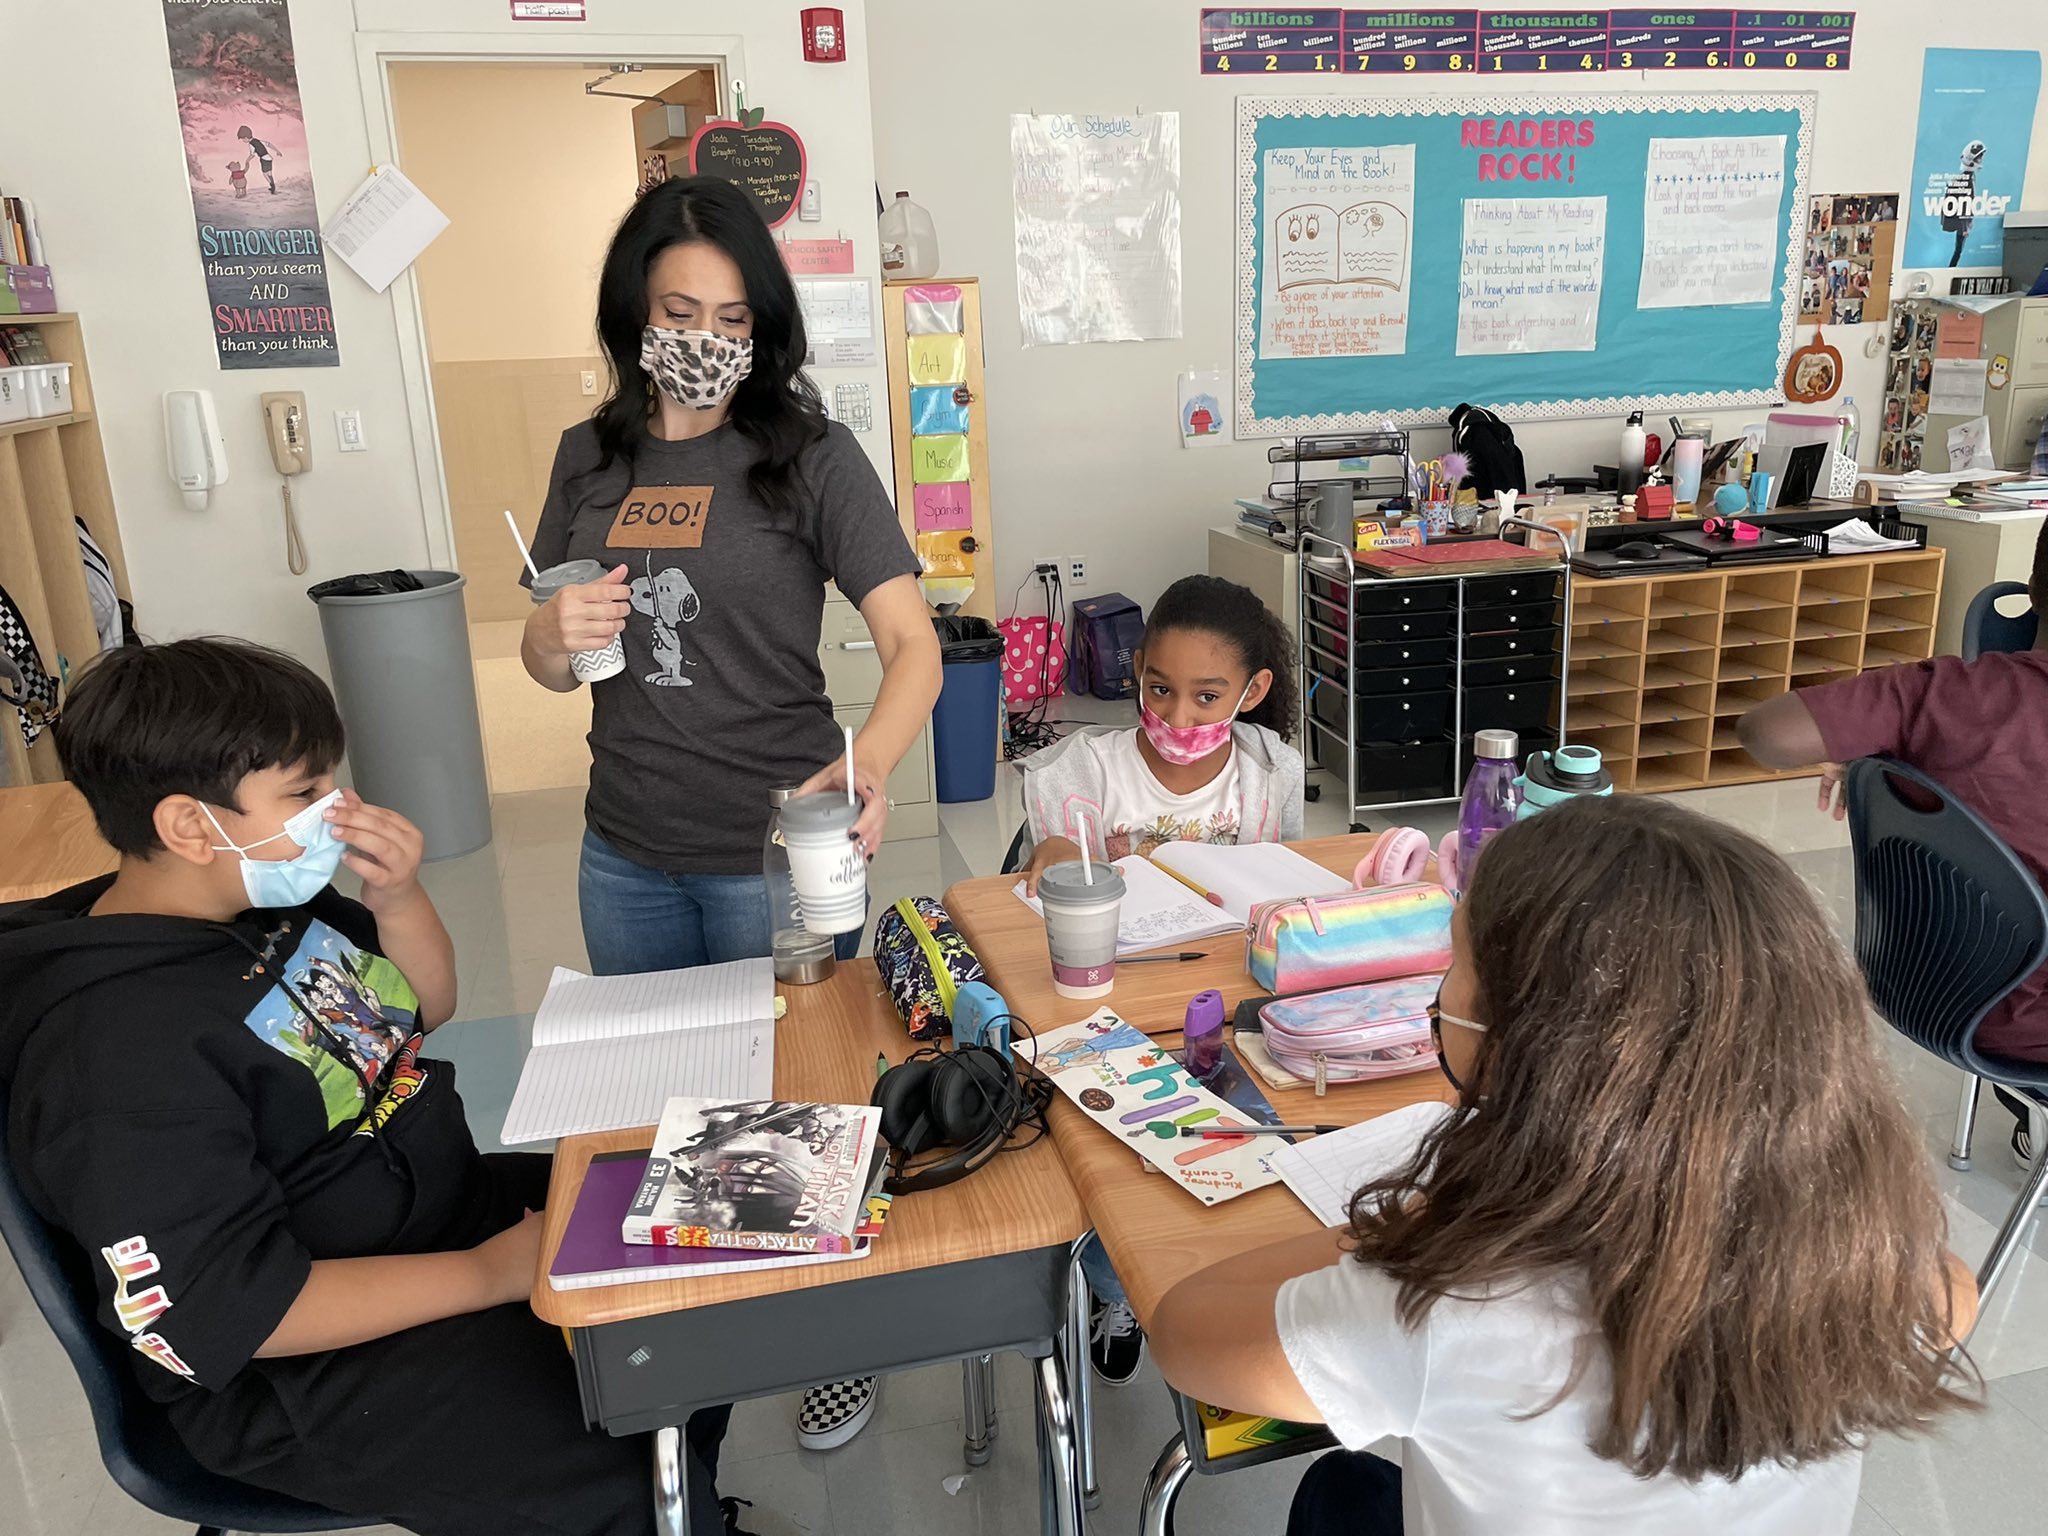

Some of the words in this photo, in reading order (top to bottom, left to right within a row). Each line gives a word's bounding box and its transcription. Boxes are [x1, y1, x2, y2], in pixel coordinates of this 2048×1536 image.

[524, 4, 546, 15] half
[547, 4, 570, 17] past
[1230, 12, 1315, 26] billions
[1366, 12, 1456, 27] millions
[1489, 14, 1599, 28] thousands
[1650, 14, 1696, 25] ones
[1747, 14, 1762, 25] .1
[1781, 14, 1806, 26] .01
[1816, 14, 1851, 28] .001
[1211, 31, 1247, 45] hundred
[1256, 33, 1271, 42] ten
[1257, 37, 1288, 50] billions
[1302, 35, 1334, 48] billions
[1352, 31, 1387, 46] hundred
[1393, 33, 1408, 43] ten
[1394, 37, 1427, 50] millions
[1436, 35, 1468, 48] millions
[1483, 32, 1517, 46] hundred
[1527, 34, 1542, 42] ten
[1528, 35, 1568, 50] thousands
[1567, 33, 1607, 47] thousands
[1615, 33, 1652, 47] hundreds
[1663, 36, 1680, 45] tens
[1703, 36, 1721, 46] ones
[1741, 36, 1765, 47] tenths
[1774, 33, 1816, 48] hundredths
[1811, 35, 1850, 49] thousandths
[1212, 40, 1244, 53] billions
[1353, 40, 1386, 53] millions
[1484, 38, 1524, 53] thousands
[1217, 55, 1231, 71] 4
[1265, 55, 1278, 71] 2
[1358, 55, 1370, 71] 7
[1403, 55, 1417, 71] 9
[1493, 55, 1503, 71] 1
[1538, 54, 1548, 70] 1
[1621, 52, 1633, 68] 3
[1664, 51, 1677, 67] 2
[1744, 51, 1756, 67] 0
[1785, 52, 1798, 68] 0
[1825, 53, 1838, 68] 8
[1051, 115, 1078, 133] Our
[1084, 115, 1133, 134] Schedule
[1460, 119, 1596, 148] READERS
[1271, 149, 1296, 169] Keep
[1304, 148, 1326, 166] Your
[1330, 148, 1353, 169] Eyes
[1362, 149, 1381, 170] and
[1295, 164, 1320, 180] Mind
[1323, 169, 1336, 179] on
[1341, 165, 1358, 180] the
[1362, 162, 1397, 180] Book!
[1478, 152, 1576, 184] ROCK!
[1922, 188, 2012, 217] wonder
[1471, 203, 1512, 226] Thinking
[1516, 204, 1544, 220] About
[1546, 203, 1561, 223] My
[1561, 202, 1594, 225] Reading
[201, 225, 320, 256] STRONGER
[1464, 239, 1489, 256] What
[1493, 242, 1503, 256] is
[1506, 238, 1544, 260] happening
[1559, 242, 1570, 260] my
[1574, 236, 1602, 253] book?
[785, 246, 815, 255] SCHOOL
[816, 246, 844, 254] SAFETY
[801, 256, 830, 265] CENTER
[1462, 260, 1474, 277] Do
[1482, 259, 1524, 276] understand
[1525, 259, 1546, 275] what
[1564, 257, 1599, 279] reading?
[207, 260, 246, 277] than
[246, 265, 279, 280] you
[281, 263, 323, 276] seem
[248, 283, 290, 300] AND
[1280, 290, 1292, 304] Be
[1320, 287, 1330, 300] of
[1331, 289, 1349, 302] your
[1461, 280, 1474, 299] Do
[1505, 281, 1525, 295] what
[1558, 278, 1572, 293] the
[1572, 278, 1598, 293] words
[1471, 294, 1506, 310] mean?
[215, 304, 334, 334] SMARTER
[221, 336, 257, 352] than
[257, 339, 288, 355] you
[291, 334, 335, 350] think.
[918, 352, 941, 374] Art
[921, 399, 951, 429] Gym
[925, 450, 954, 470] Music
[621, 501, 702, 527] BOO!
[923, 498, 965, 524] Spanish
[1359, 525, 1377, 534] GLAD
[823, 1142, 842, 1164] on
[650, 1163, 668, 1178] 33
[1179, 1169, 1234, 1181] Counts
[665, 1226, 678, 1246] YA
[709, 1232, 742, 1247] TITA
[742, 1236, 757, 1246] on
[756, 1233, 817, 1250] ATTACK
